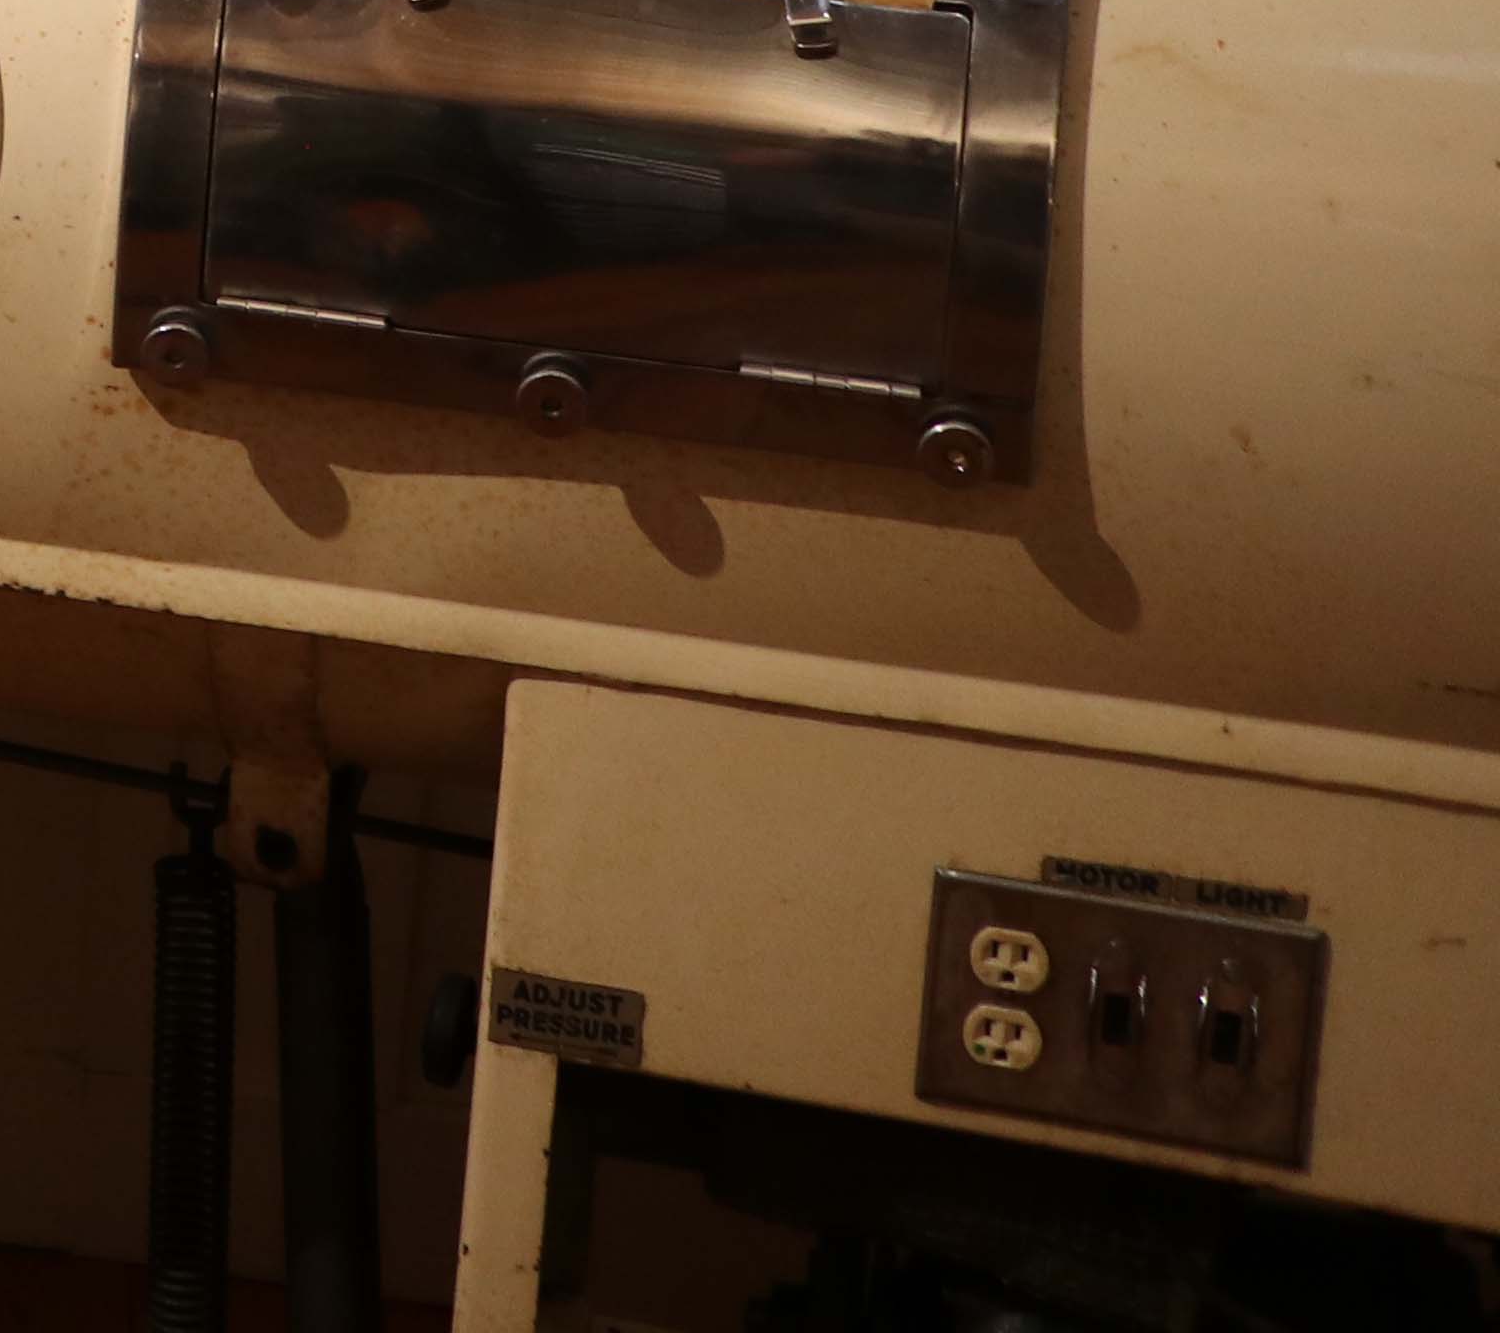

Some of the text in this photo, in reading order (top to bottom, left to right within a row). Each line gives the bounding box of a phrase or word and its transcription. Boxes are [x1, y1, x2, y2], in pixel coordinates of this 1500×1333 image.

[1051, 859, 1160, 895] MOTOR
[1196, 880, 1291, 914] LIGHT
[513, 979, 623, 1018] ADJUST
[497, 1003, 635, 1046] PRESSURE
